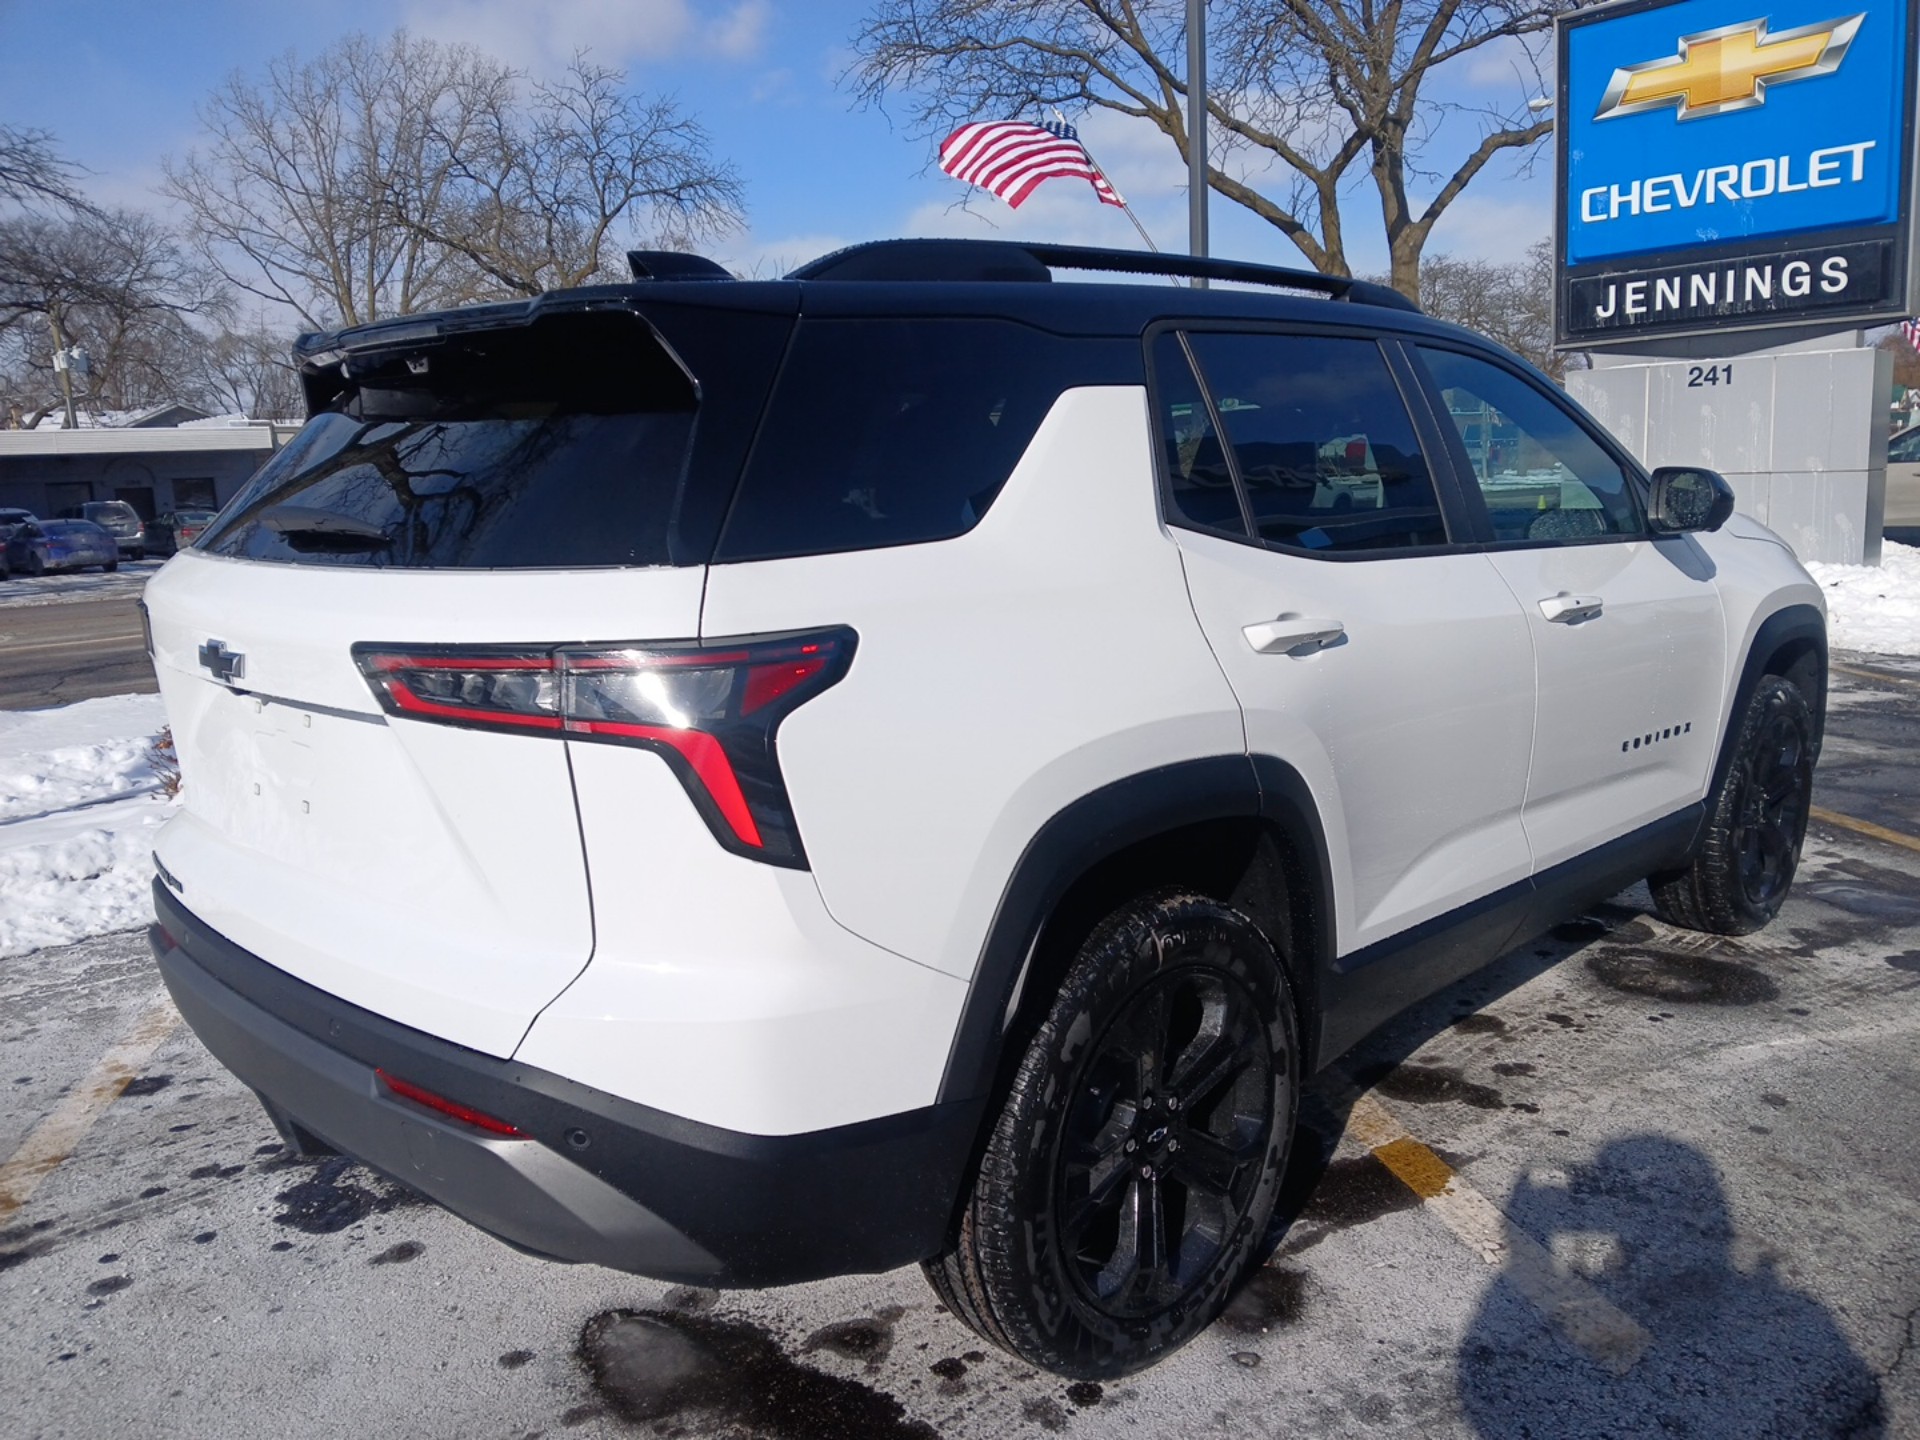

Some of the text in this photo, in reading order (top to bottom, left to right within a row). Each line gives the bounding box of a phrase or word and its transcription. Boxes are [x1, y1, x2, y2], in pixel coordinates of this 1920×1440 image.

[1581, 140, 1876, 223] CHEVROLET
[1596, 256, 1849, 318] JENNINGS
[1688, 364, 1733, 387] 241
[1621, 722, 1692, 753] EQUINOX
